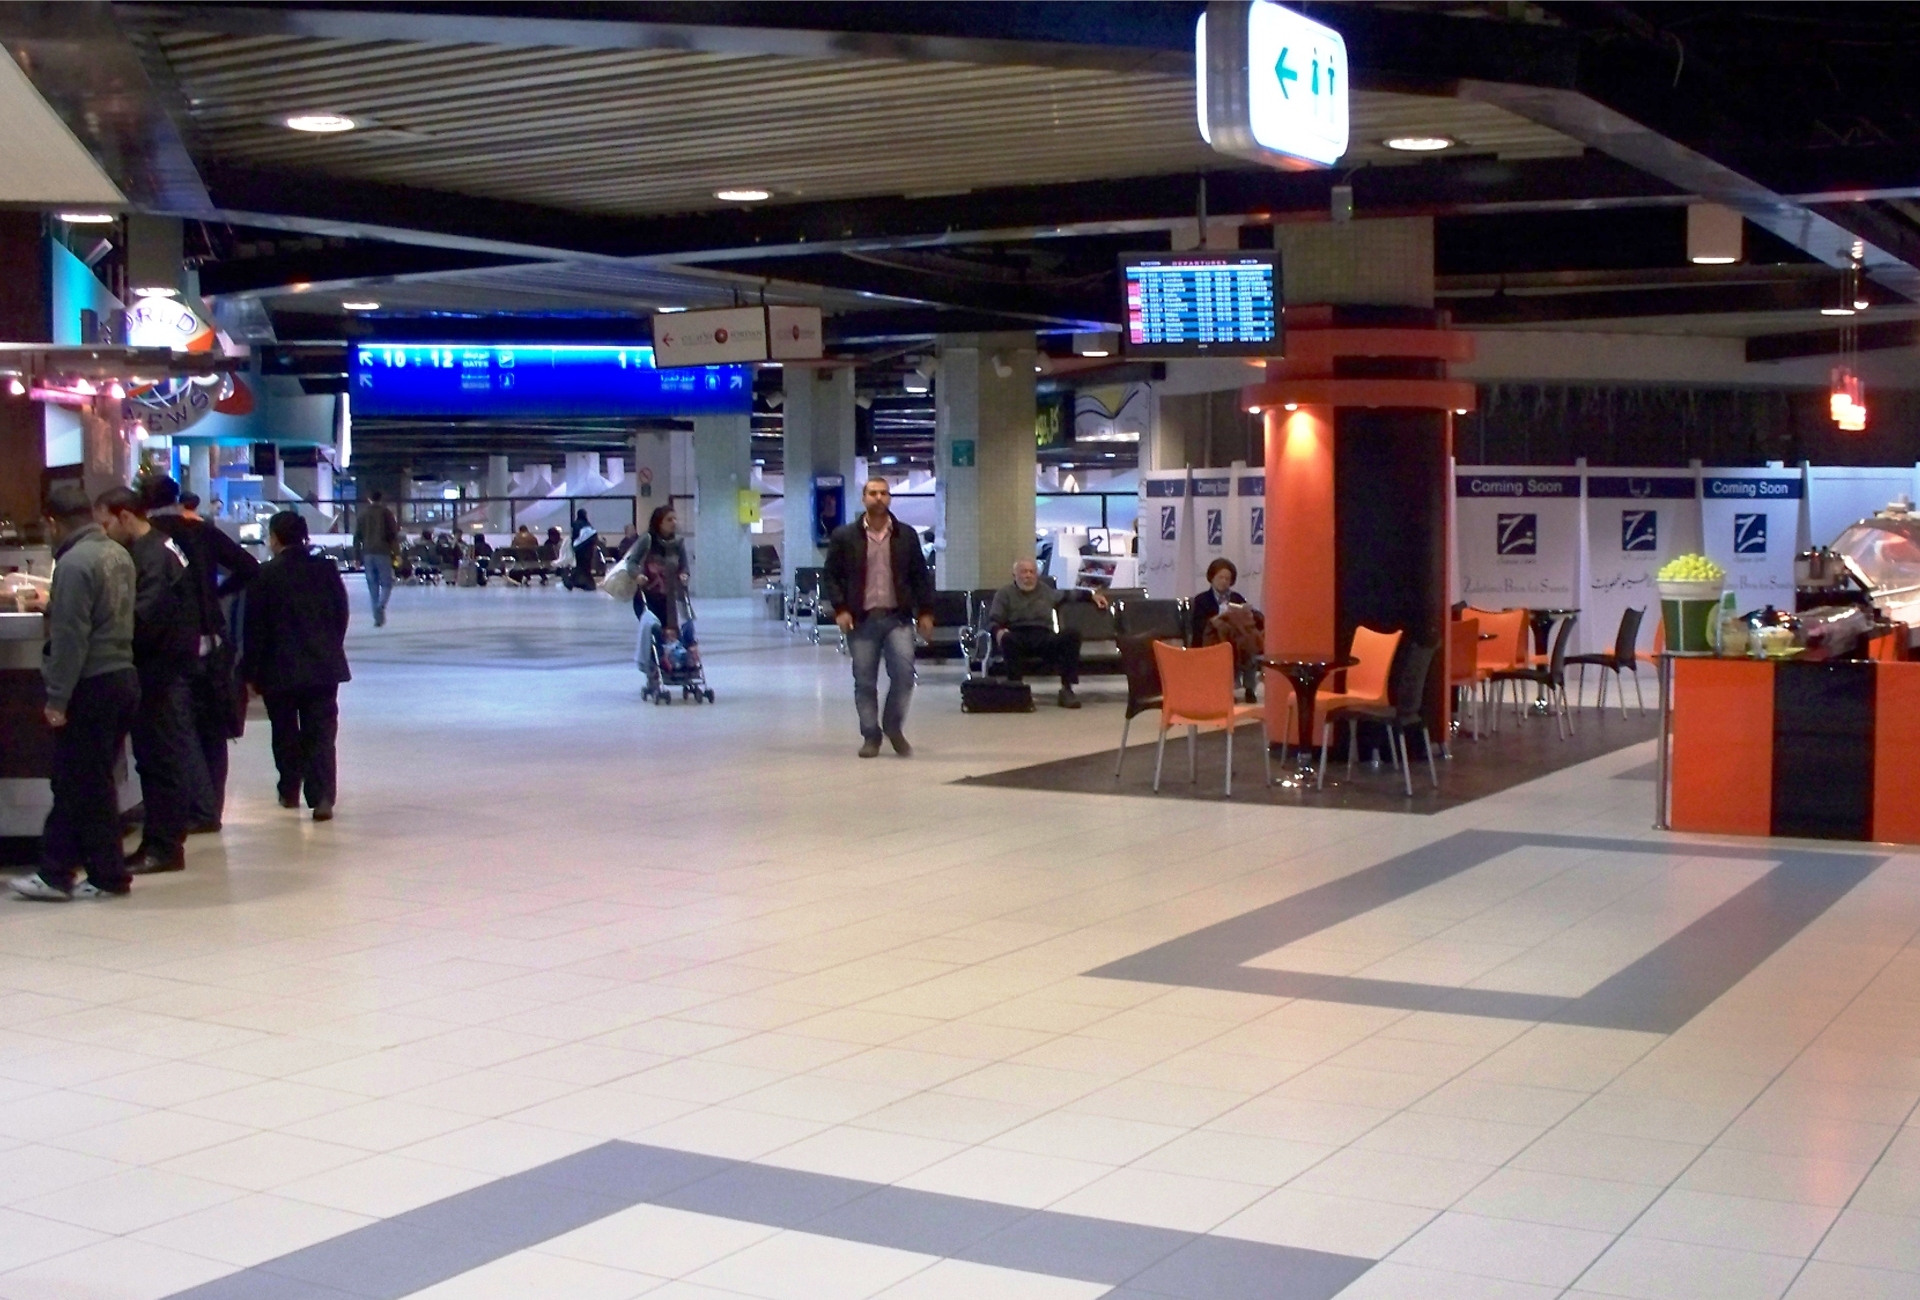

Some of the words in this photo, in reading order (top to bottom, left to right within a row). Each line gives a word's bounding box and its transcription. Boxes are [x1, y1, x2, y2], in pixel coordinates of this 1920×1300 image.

[382, 350, 407, 368] 10
[430, 350, 454, 368] 12
[1471, 479, 1524, 496] Coming
[1527, 479, 1562, 493] Soon
[1712, 481, 1757, 497] Coming
[1759, 481, 1789, 494] Soon
